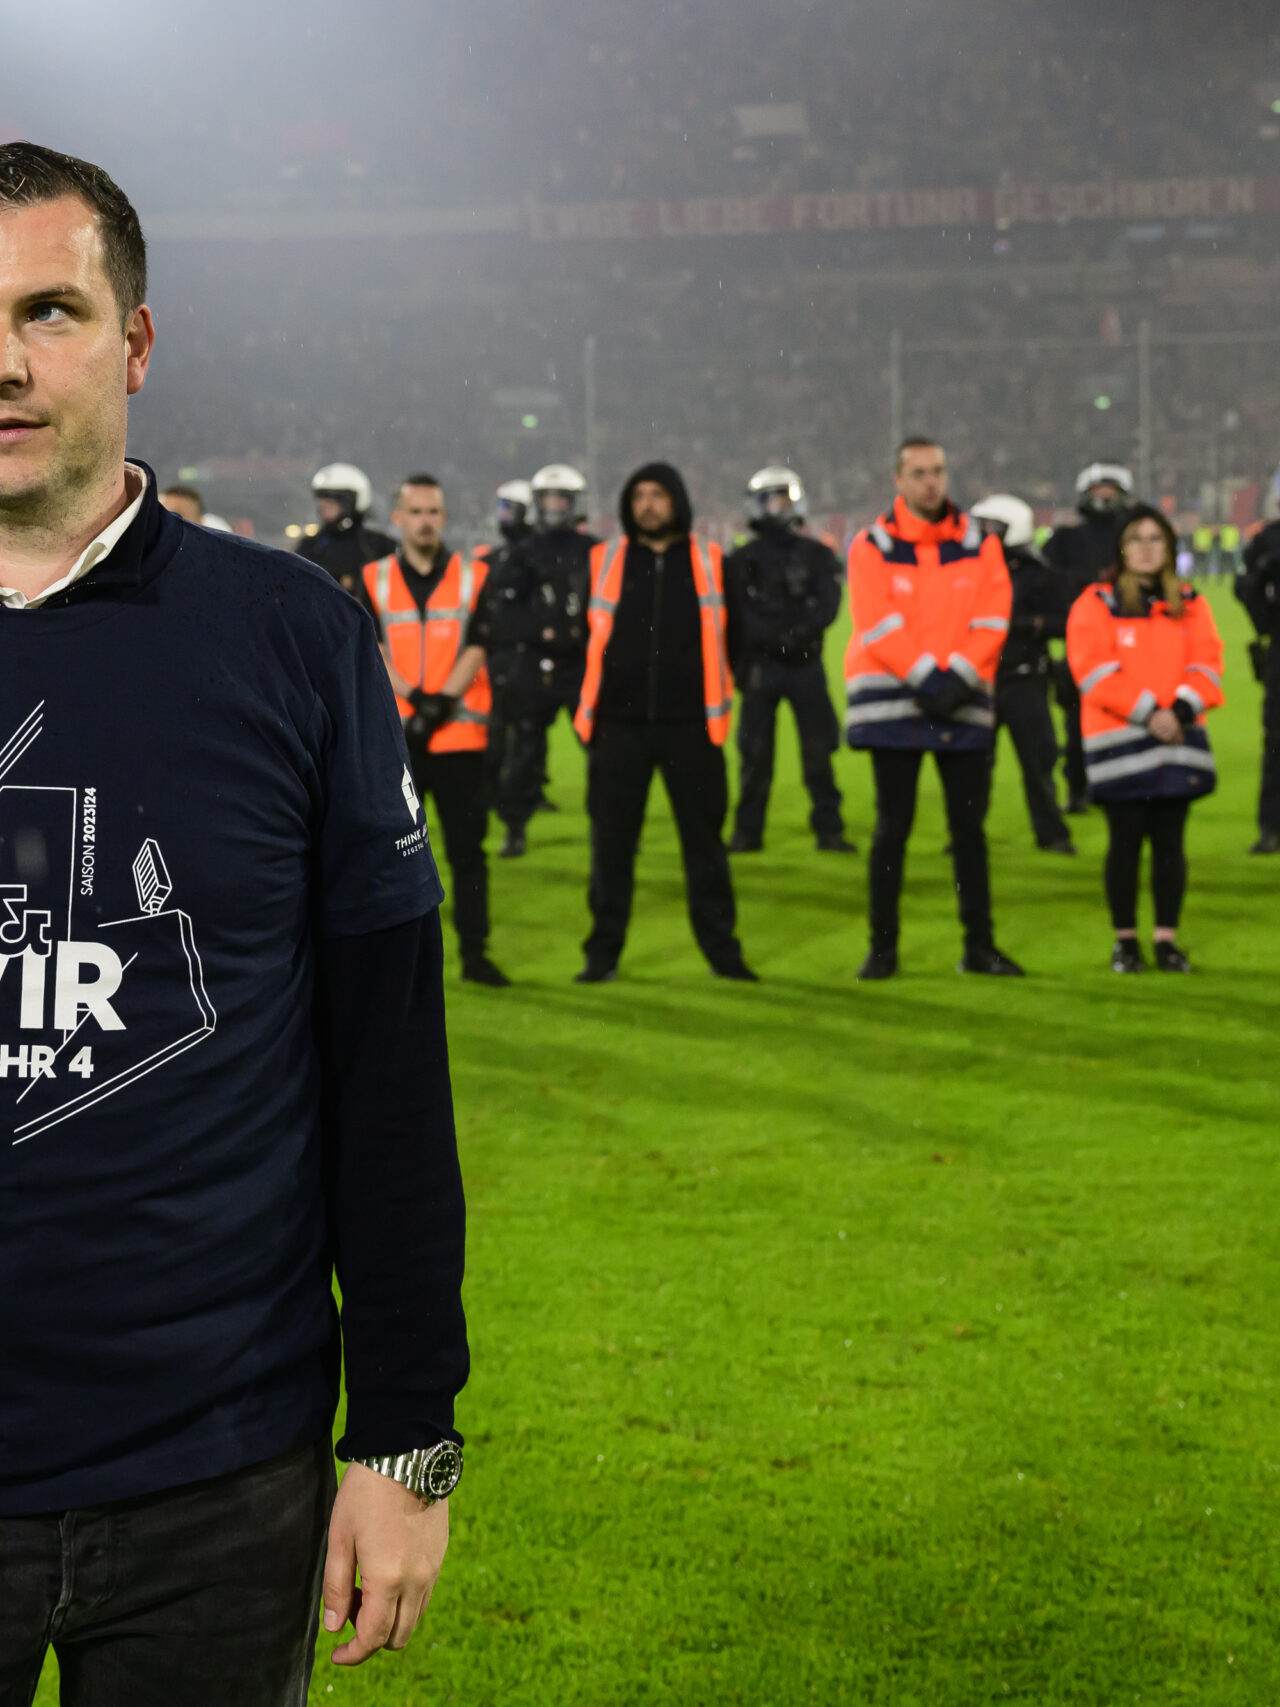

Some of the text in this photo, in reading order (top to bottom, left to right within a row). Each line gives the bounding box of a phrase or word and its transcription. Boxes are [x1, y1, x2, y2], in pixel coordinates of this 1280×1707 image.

[659, 196, 770, 236] LIEBE
[794, 187, 976, 230] FORTUNA
[80, 845, 95, 896] SAISON
[68, 1046, 94, 1079] 4
